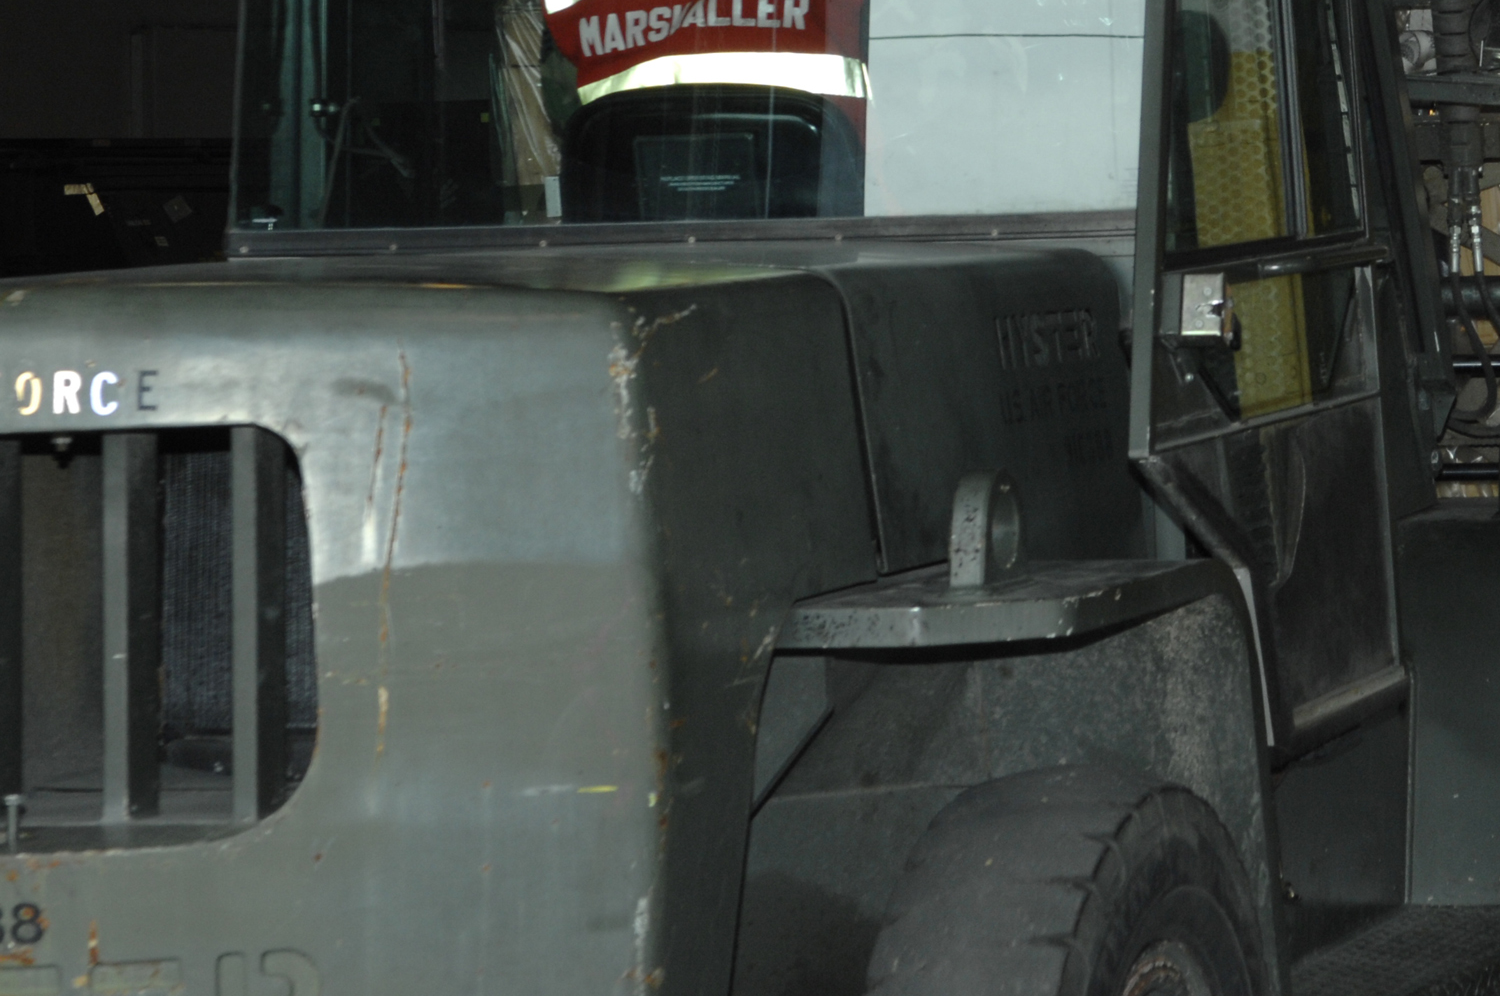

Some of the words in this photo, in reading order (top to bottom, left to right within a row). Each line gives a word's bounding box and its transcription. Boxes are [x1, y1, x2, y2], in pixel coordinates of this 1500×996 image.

[993, 307, 1102, 370] HYSTER
[0, 369, 159, 416] ORCE
[1056, 376, 1108, 415] FORCE
[0, 902, 45, 944] 8
